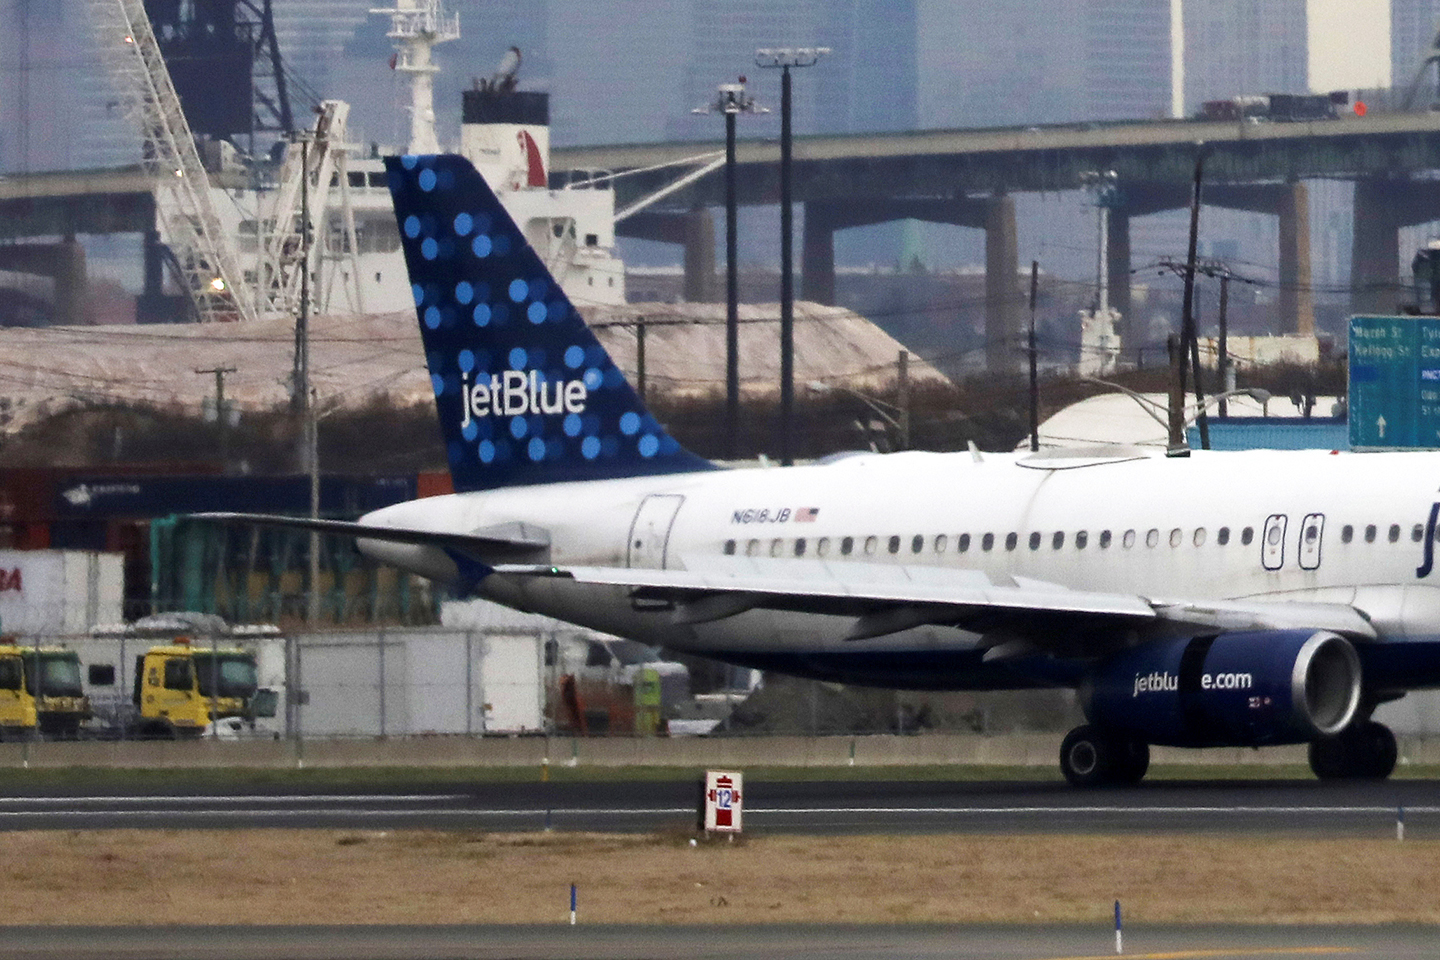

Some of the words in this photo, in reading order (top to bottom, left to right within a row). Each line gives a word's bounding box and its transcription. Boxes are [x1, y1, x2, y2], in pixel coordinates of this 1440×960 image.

[1391, 326, 1402, 338] St
[1354, 344, 1394, 359] Kellogg
[1398, 345, 1411, 357] St
[461, 369, 588, 429] jetBlue
[731, 507, 792, 524] N618JB
[717, 789, 732, 808] 12
